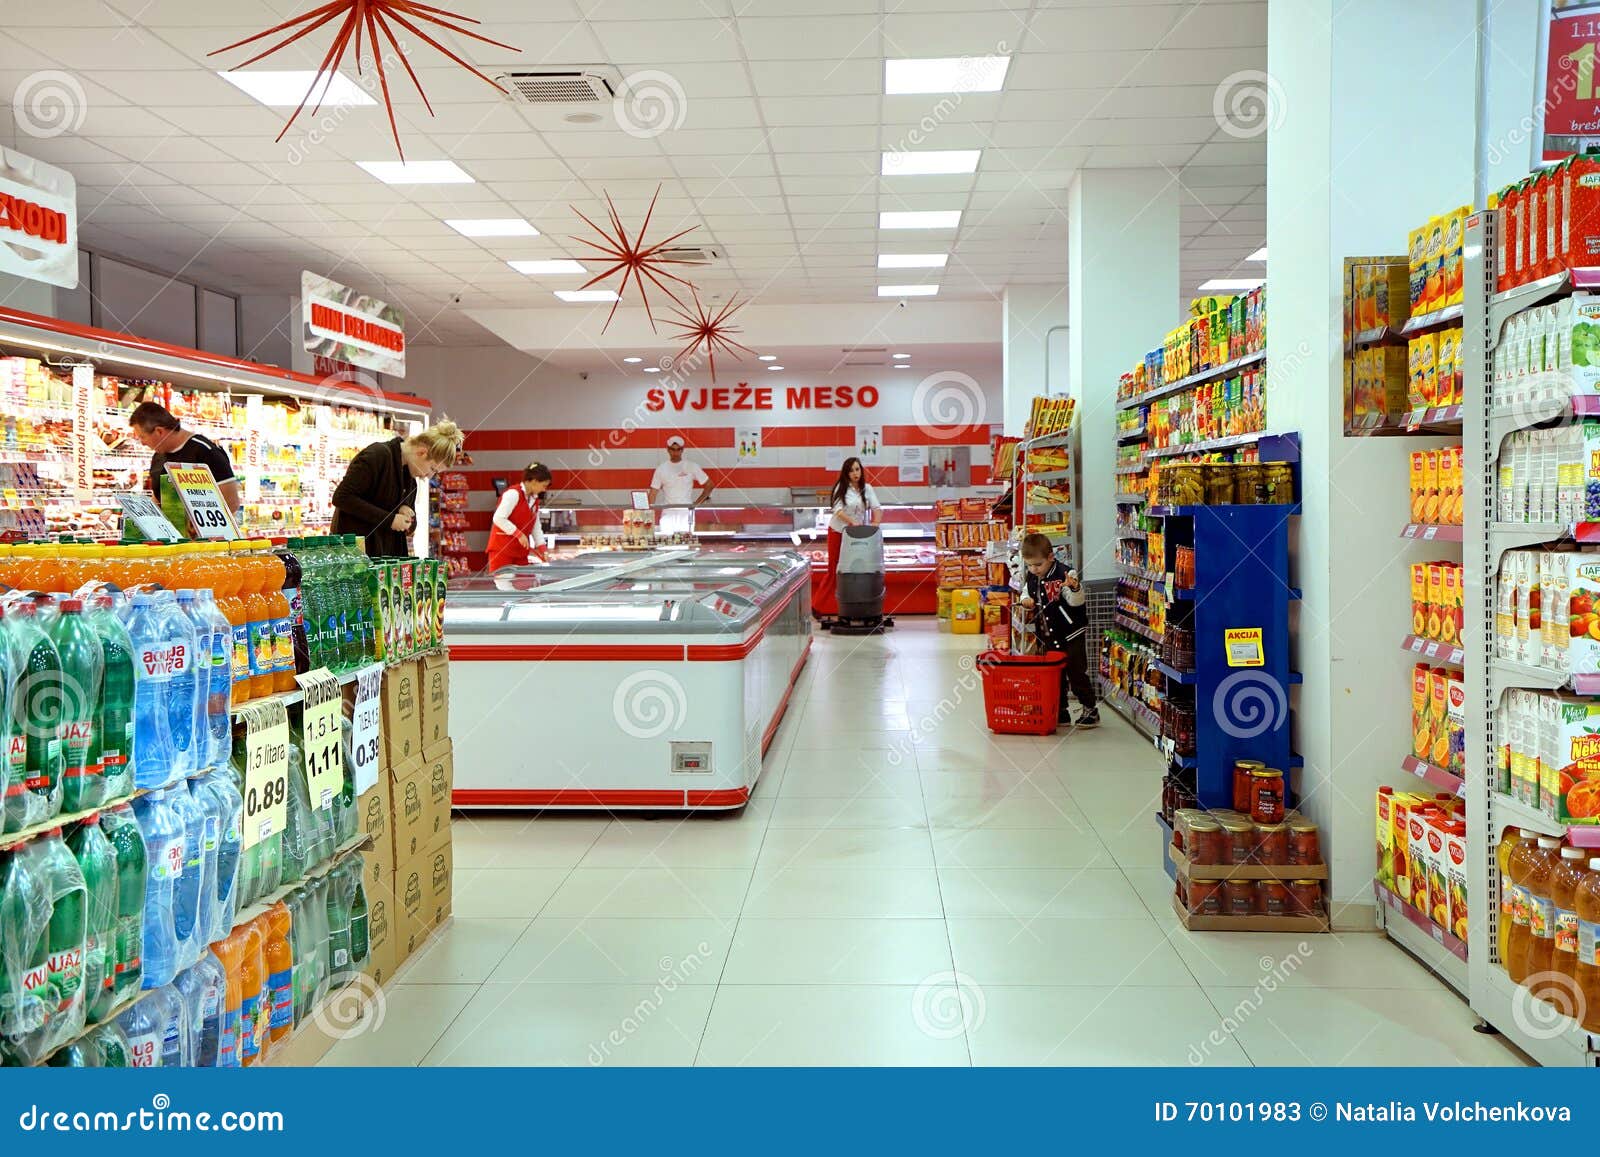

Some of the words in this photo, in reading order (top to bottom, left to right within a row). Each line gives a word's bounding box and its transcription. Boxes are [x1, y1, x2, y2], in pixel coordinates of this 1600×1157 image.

[311, 302, 343, 334] MINI
[645, 382, 773, 412] SVJEŽE
[786, 385, 879, 410] MESO
[193, 509, 227, 528] 0.99
[1228, 631, 1259, 640] AKCIJA
[306, 716, 326, 741] 1.5
[330, 712, 339, 733] L
[263, 742, 286, 766] litara
[308, 741, 340, 778] 1.11
[246, 776, 286, 817] 0.89
